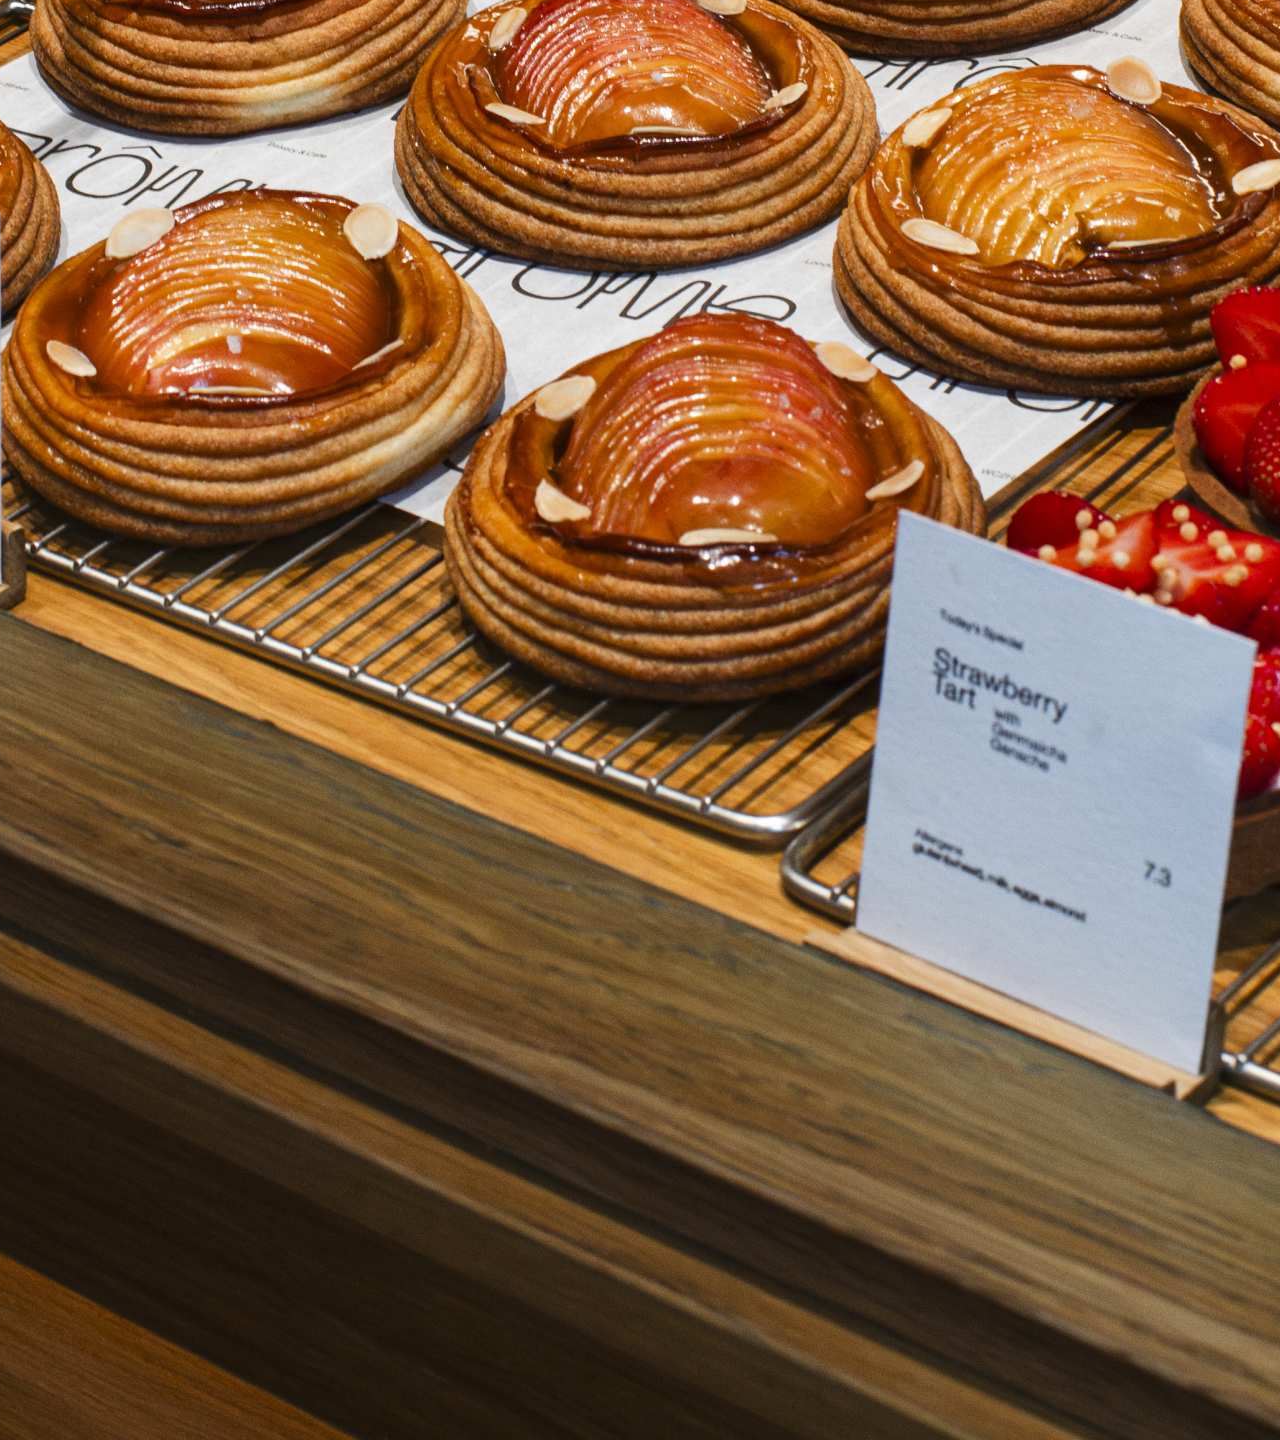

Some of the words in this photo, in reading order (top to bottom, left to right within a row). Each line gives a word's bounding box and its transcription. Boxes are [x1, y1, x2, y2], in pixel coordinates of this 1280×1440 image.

[932, 669, 976, 710] Tart
[933, 647, 1069, 725] Strawberry
[994, 708, 1021, 726] with
[989, 737, 1050, 772] Ganache
[1143, 861, 1173, 888] 7.3
